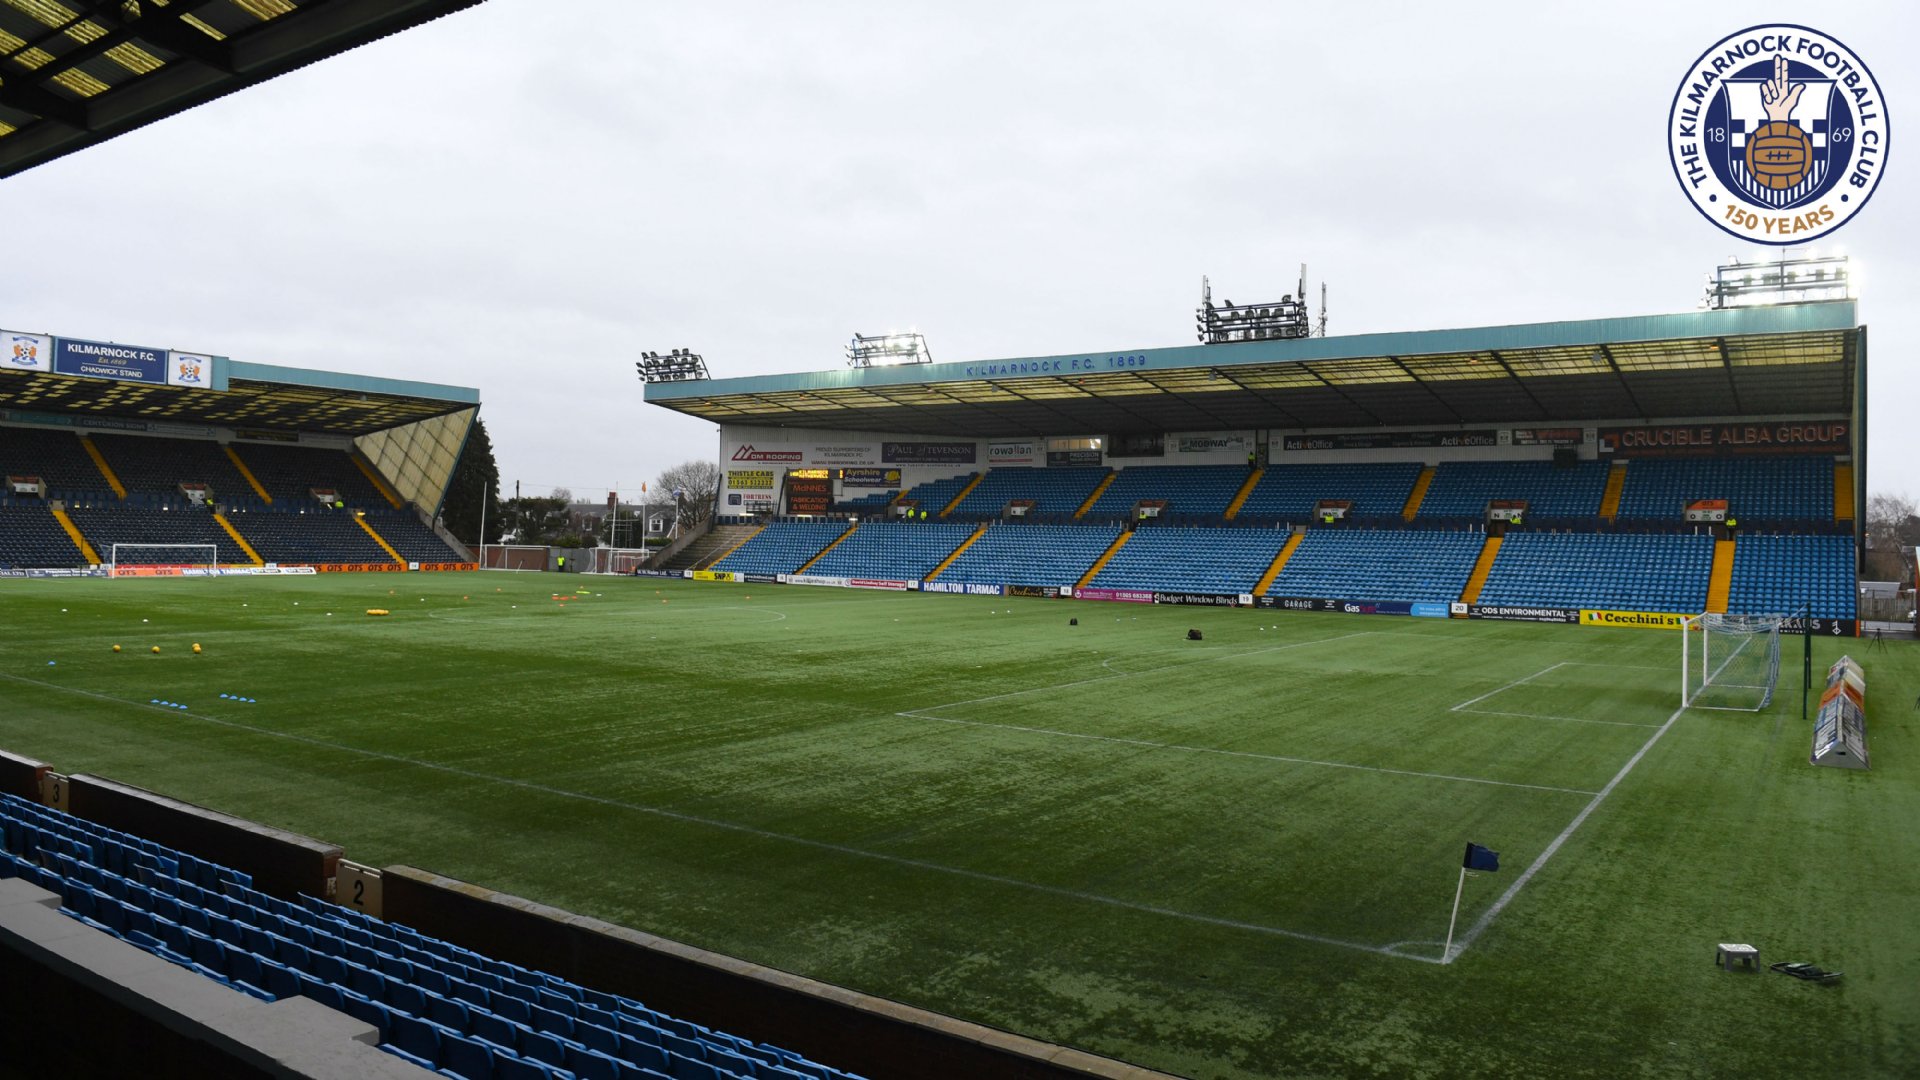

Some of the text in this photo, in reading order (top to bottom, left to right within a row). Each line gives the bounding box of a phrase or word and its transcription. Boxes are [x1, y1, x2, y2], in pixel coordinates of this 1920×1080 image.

[67, 343, 138, 359] KILMARNOCK
[80, 365, 143, 378] CHADWICK STAND
[966, 360, 1061, 376] KILMARNOCK
[1108, 355, 1146, 367] 1869
[1622, 424, 1847, 447] CRUCIBLE ALBA GROUP
[989, 444, 1032, 455] rowallan
[846, 469, 881, 480] Ayrshire
[923, 582, 1000, 595] HAMILTON TARMAC
[1160, 594, 1184, 603] Budget
[1185, 595, 1214, 604] Window
[1215, 595, 1238, 605] Blinds
[1284, 599, 1312, 608] GARAGE
[1499, 607, 1567, 618] ENVIRONMENTAL
[1604, 613, 1674, 625] Cecchini's
[53, 784, 60, 802] 3
[353, 879, 364, 906] 2
